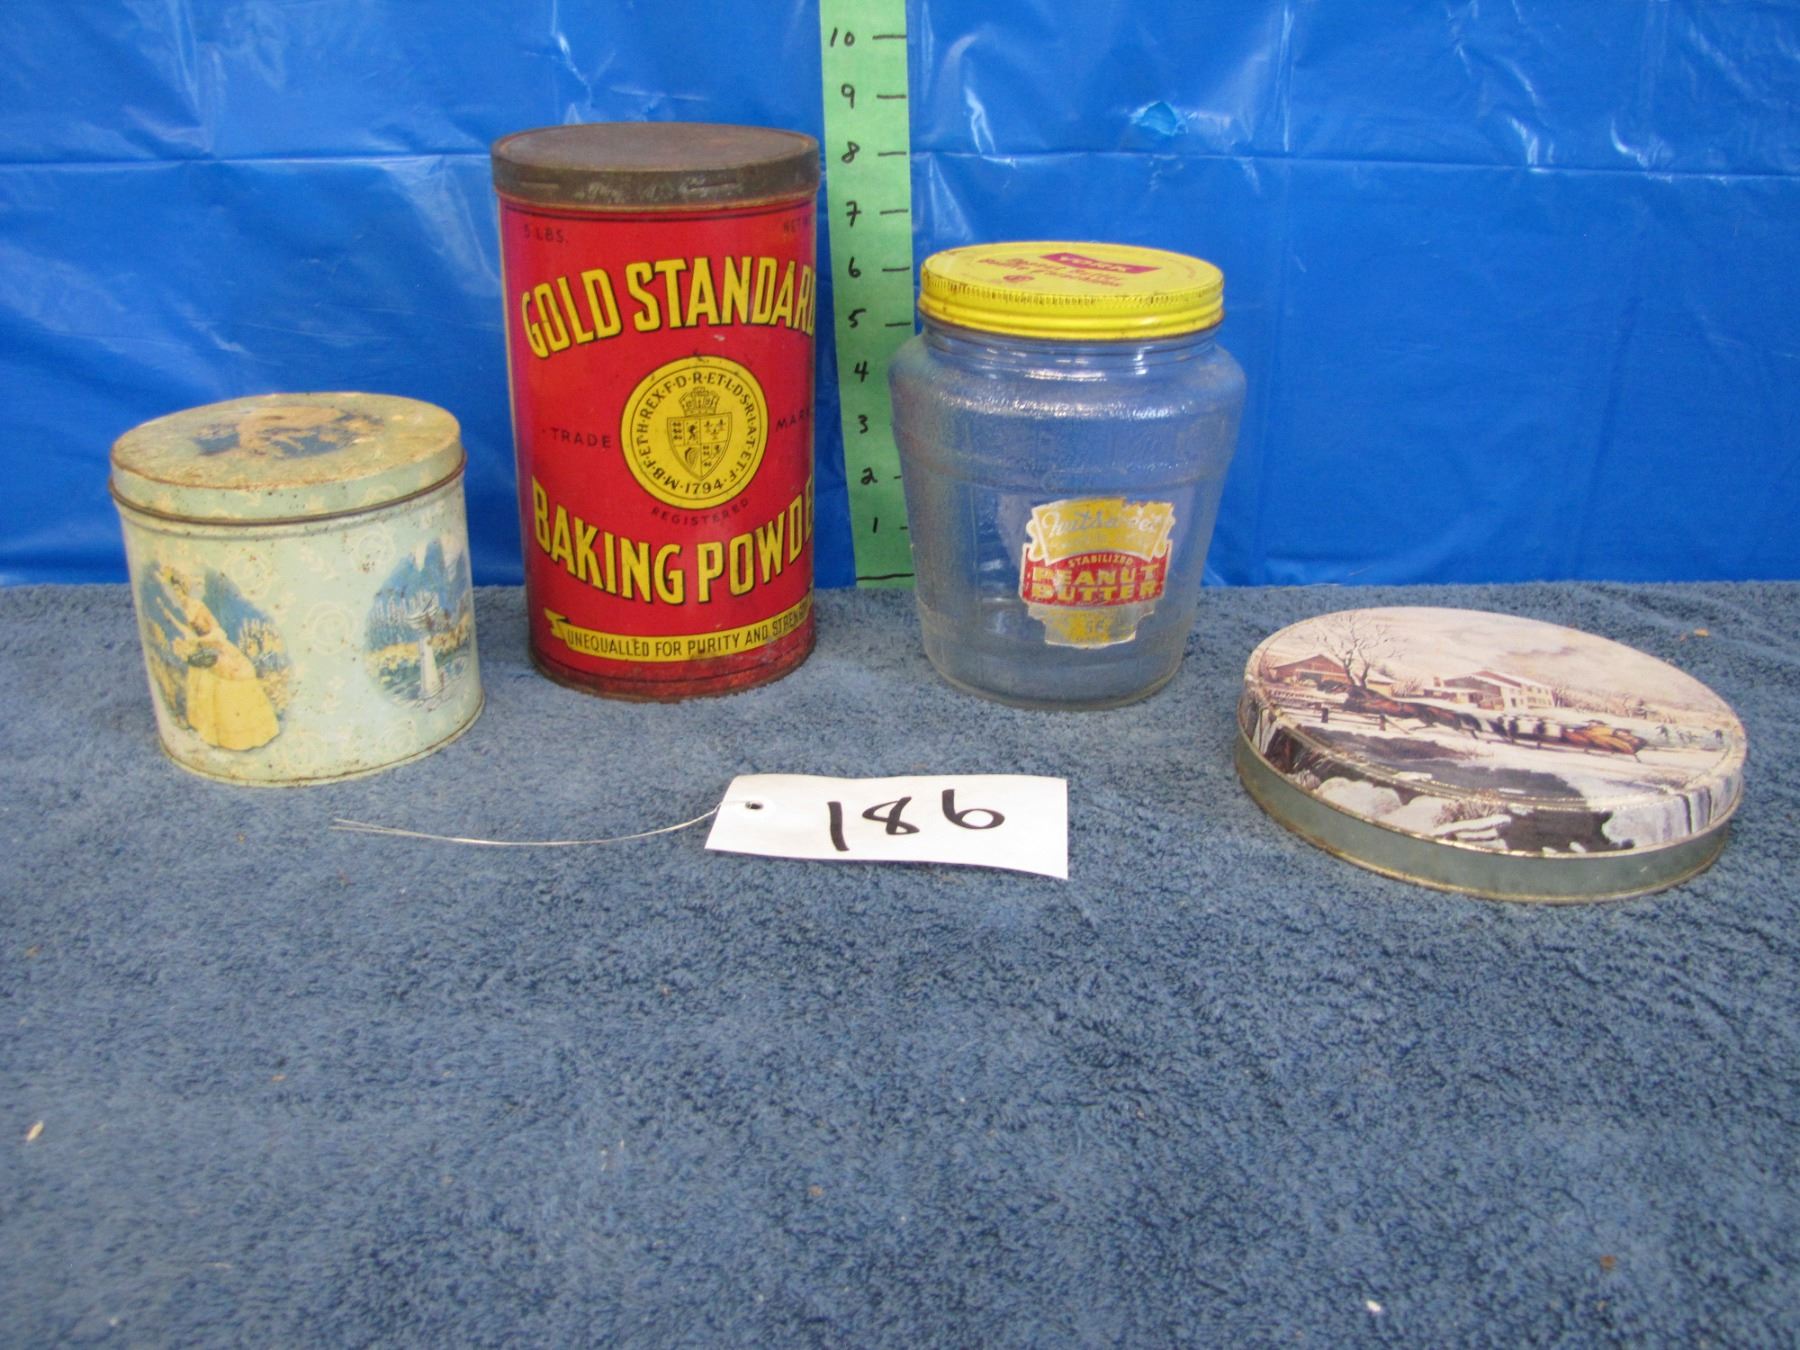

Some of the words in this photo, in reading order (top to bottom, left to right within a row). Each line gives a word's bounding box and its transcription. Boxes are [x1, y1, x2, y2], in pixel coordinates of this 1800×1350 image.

[829, 27, 855, 48] 10
[841, 83, 855, 109] 9
[841, 141, 860, 164] 8
[845, 200, 862, 227] 7
[848, 256, 861, 278] 6
[521, 268, 622, 359] GOLD
[848, 308, 866, 328] 5
[853, 360, 869, 382] 4
[857, 414, 869, 434] 3
[549, 426, 612, 449] TRADE
[684, 478, 724, 495] 1794
[860, 467, 877, 485] 2
[651, 498, 750, 526] REGISTERED
[872, 516, 879, 534] 1
[531, 474, 686, 605] BAKING
[1067, 553, 1135, 569] STABILIZED
[1032, 563, 1161, 587] PEANUT
[1031, 579, 1159, 602] BUTTER
[567, 629, 650, 657] UNEQUALLED
[655, 641, 682, 656] FOR
[687, 633, 740, 654] PURITY
[745, 627, 769, 645] AND
[827, 789, 1005, 852] 186
